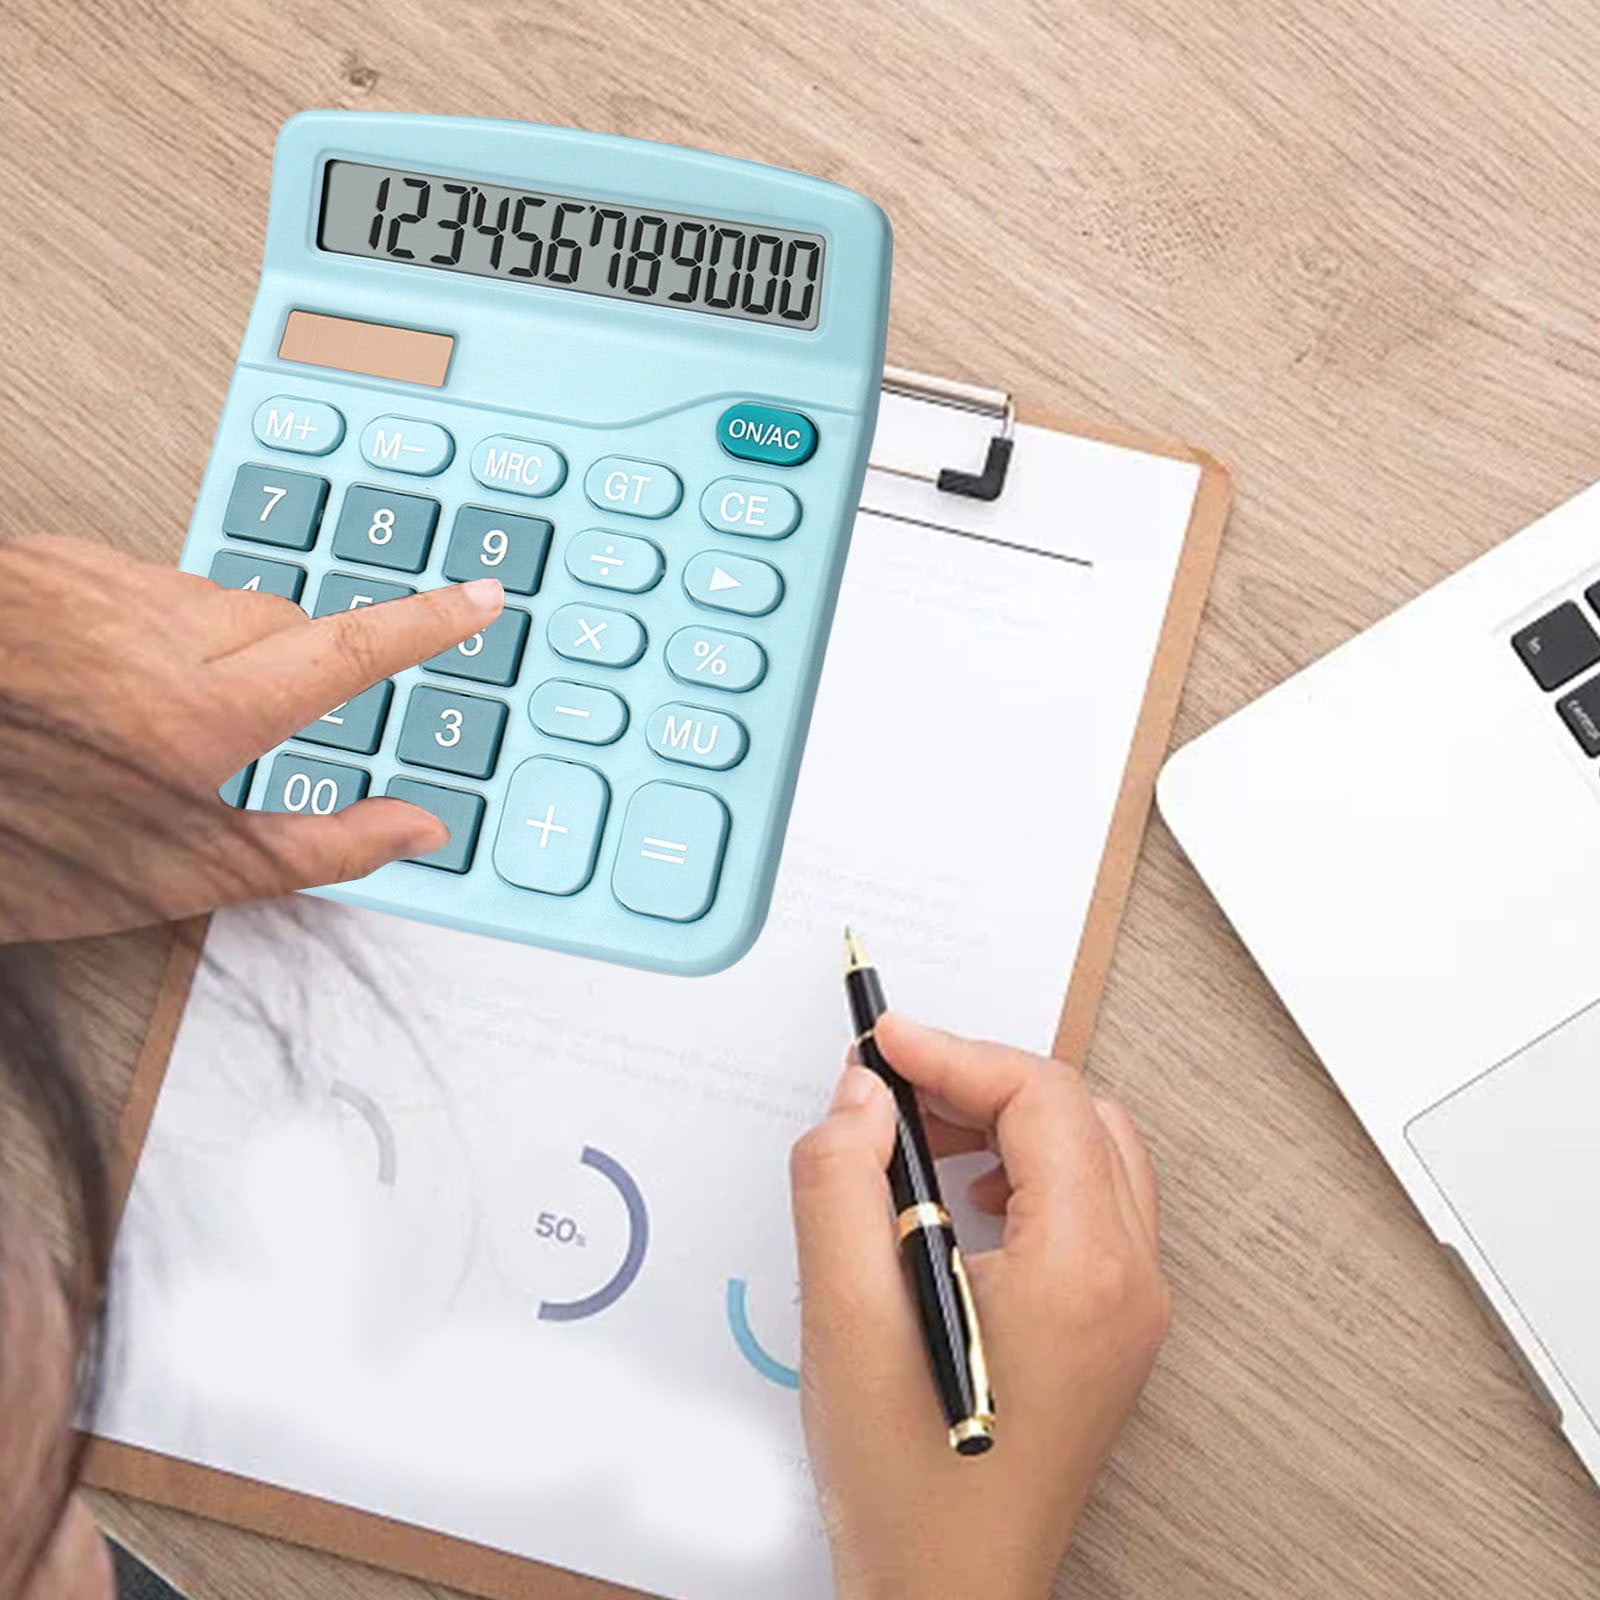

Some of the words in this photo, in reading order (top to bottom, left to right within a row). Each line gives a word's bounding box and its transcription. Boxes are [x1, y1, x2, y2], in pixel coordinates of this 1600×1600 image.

[728, 418, 802, 452] ON/AC
[483, 448, 543, 486] MRC
[260, 485, 288, 522] 7
[604, 470, 652, 505] GT
[367, 508, 396, 546] 8
[719, 491, 769, 527] CE
[479, 529, 509, 567] 9
[434, 708, 464, 748] 3
[661, 716, 719, 754] MU
[283, 773, 339, 816] 00
